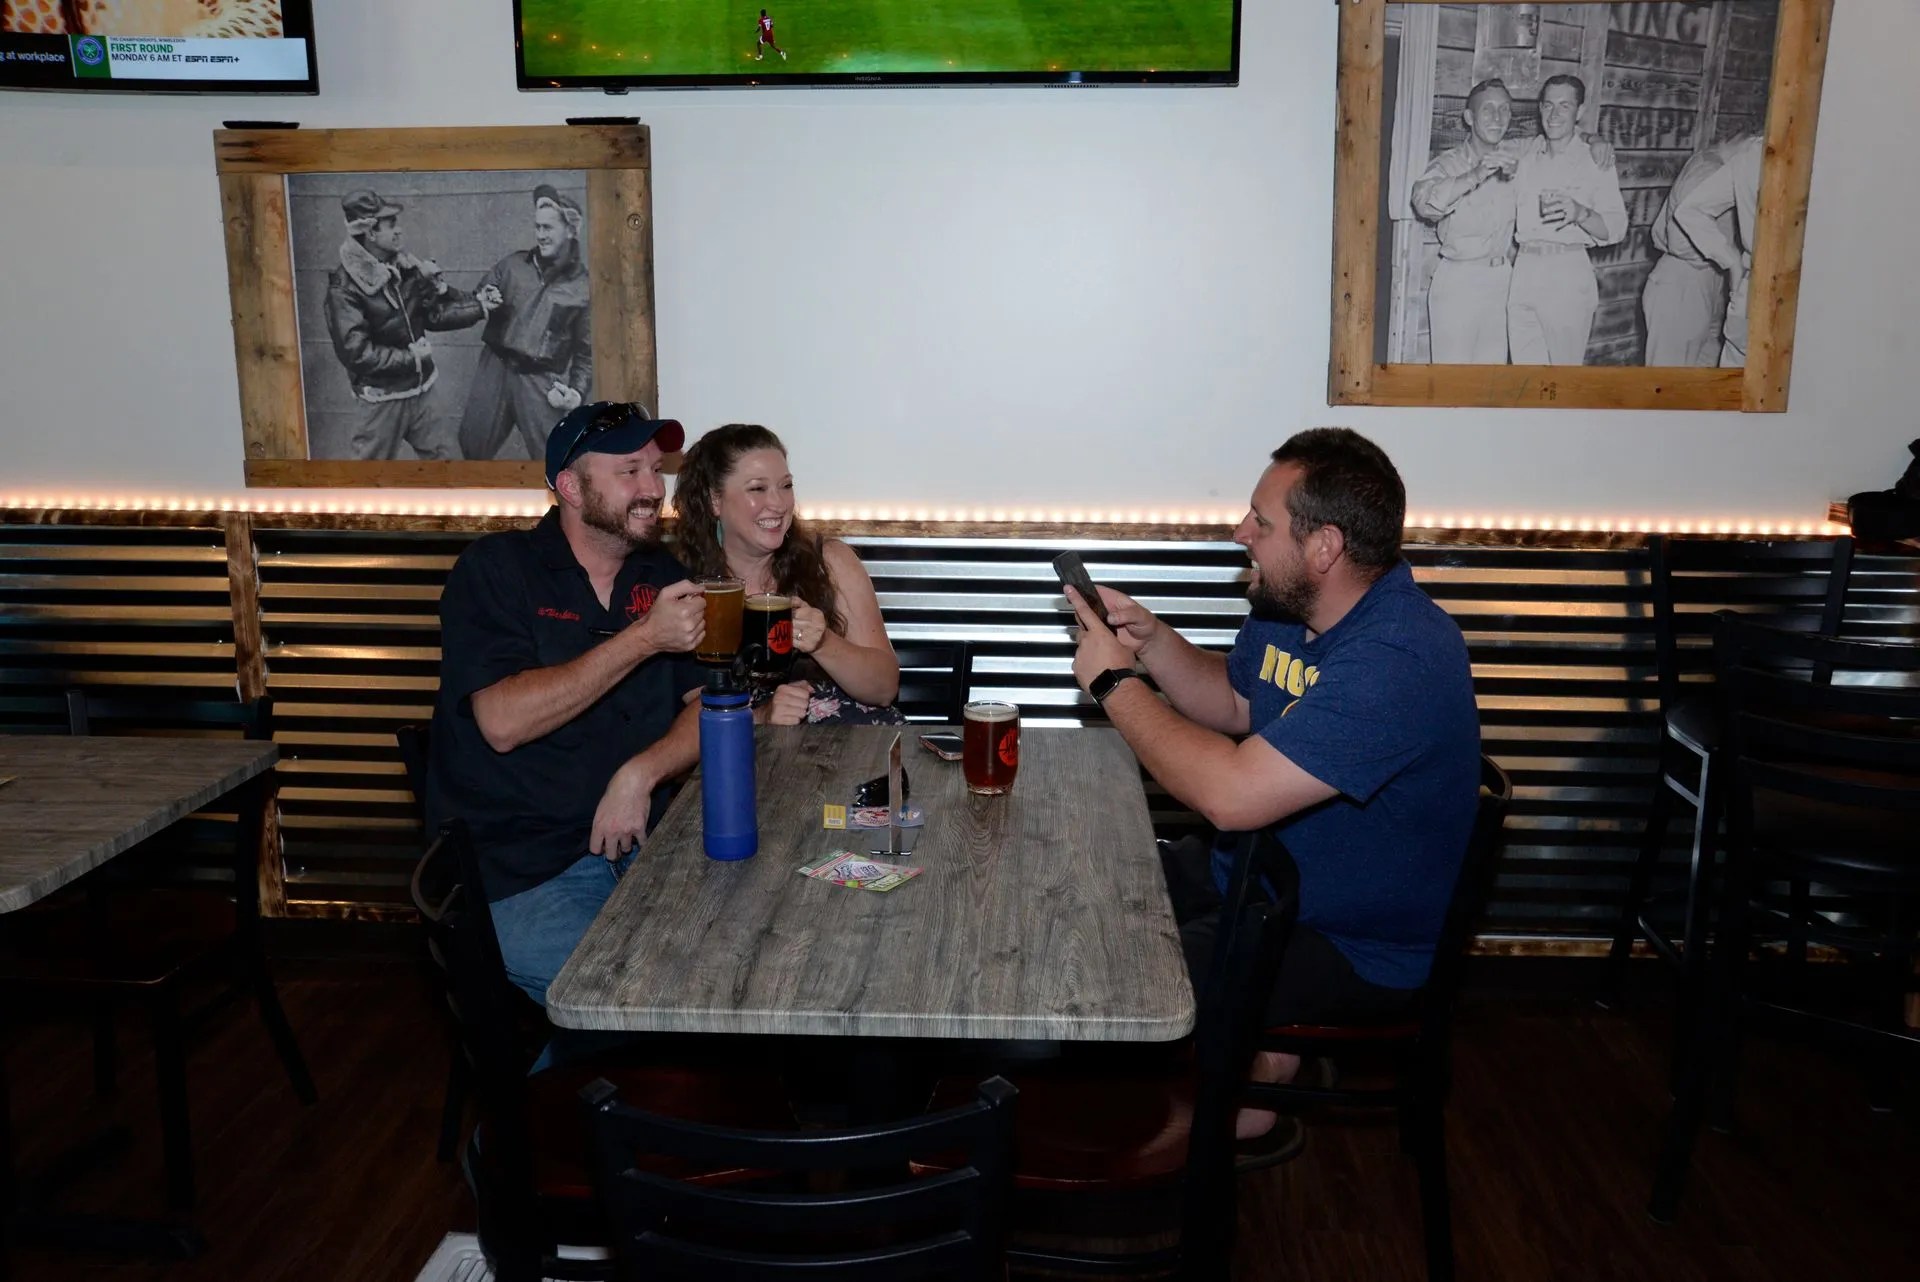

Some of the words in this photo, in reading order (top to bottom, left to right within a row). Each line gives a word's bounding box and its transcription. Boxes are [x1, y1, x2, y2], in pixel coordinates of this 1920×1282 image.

[110, 43, 138, 53] FIRST
[139, 43, 174, 54] ROUND
[6, 51, 17, 60] at
[17, 51, 65, 63] workplace
[111, 53, 148, 62] MONDAY
[150, 53, 156, 62] 6
[157, 54, 170, 62] AM
[172, 54, 182, 62] ET
[185, 55, 209, 63] ESPN
[210, 55, 240, 63] ESPN+
